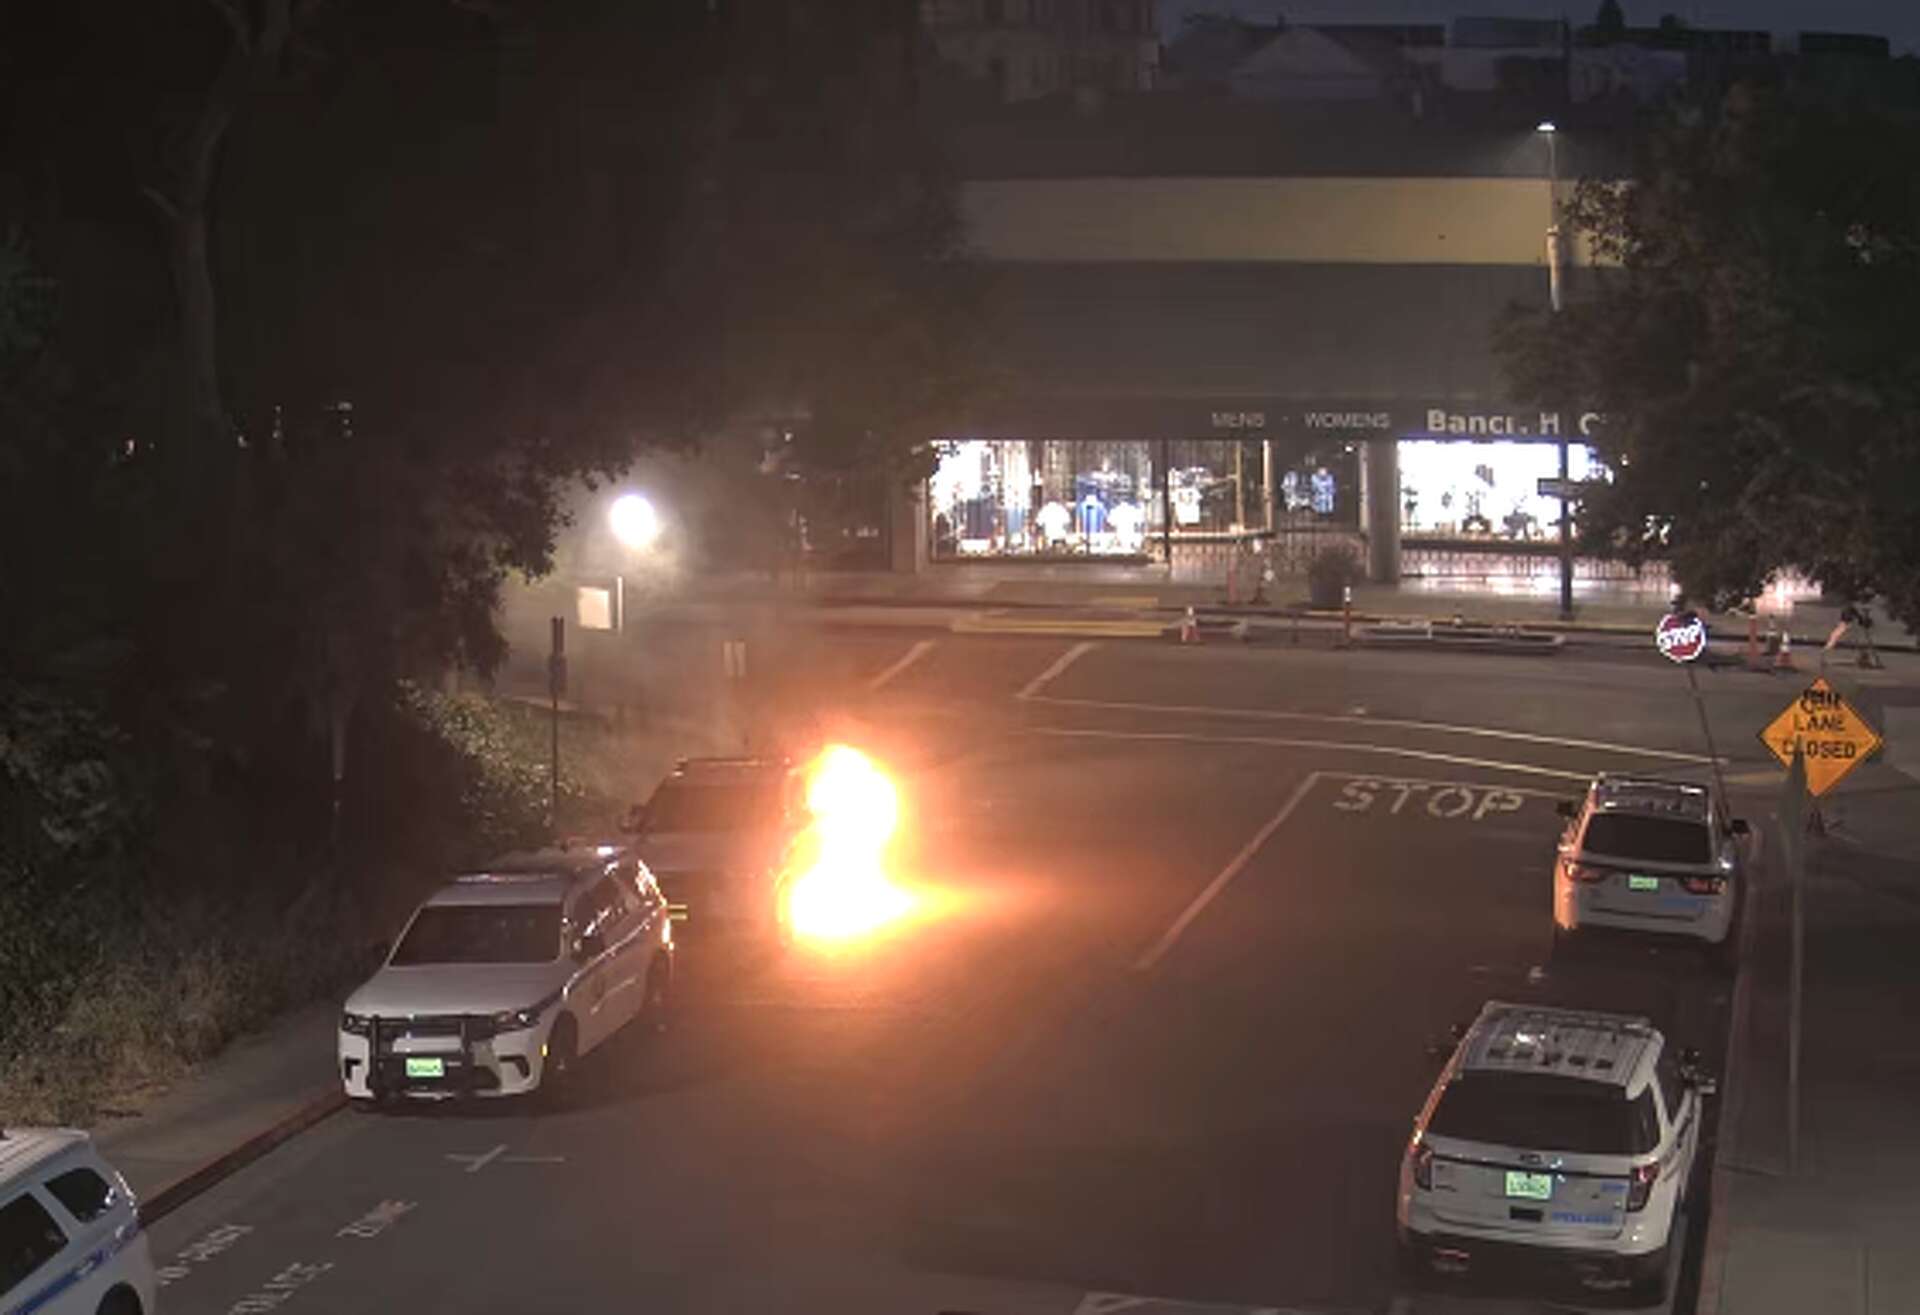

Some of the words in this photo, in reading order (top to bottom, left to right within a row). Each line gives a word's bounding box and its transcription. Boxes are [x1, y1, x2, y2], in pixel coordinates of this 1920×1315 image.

[1211, 411, 1265, 428] MENS
[1304, 411, 1392, 428] WOMENS
[1658, 624, 1698, 648] STOP
[1794, 713, 1846, 732] LANE
[1782, 739, 1856, 759] COSED
[1334, 780, 1524, 818] STOP
